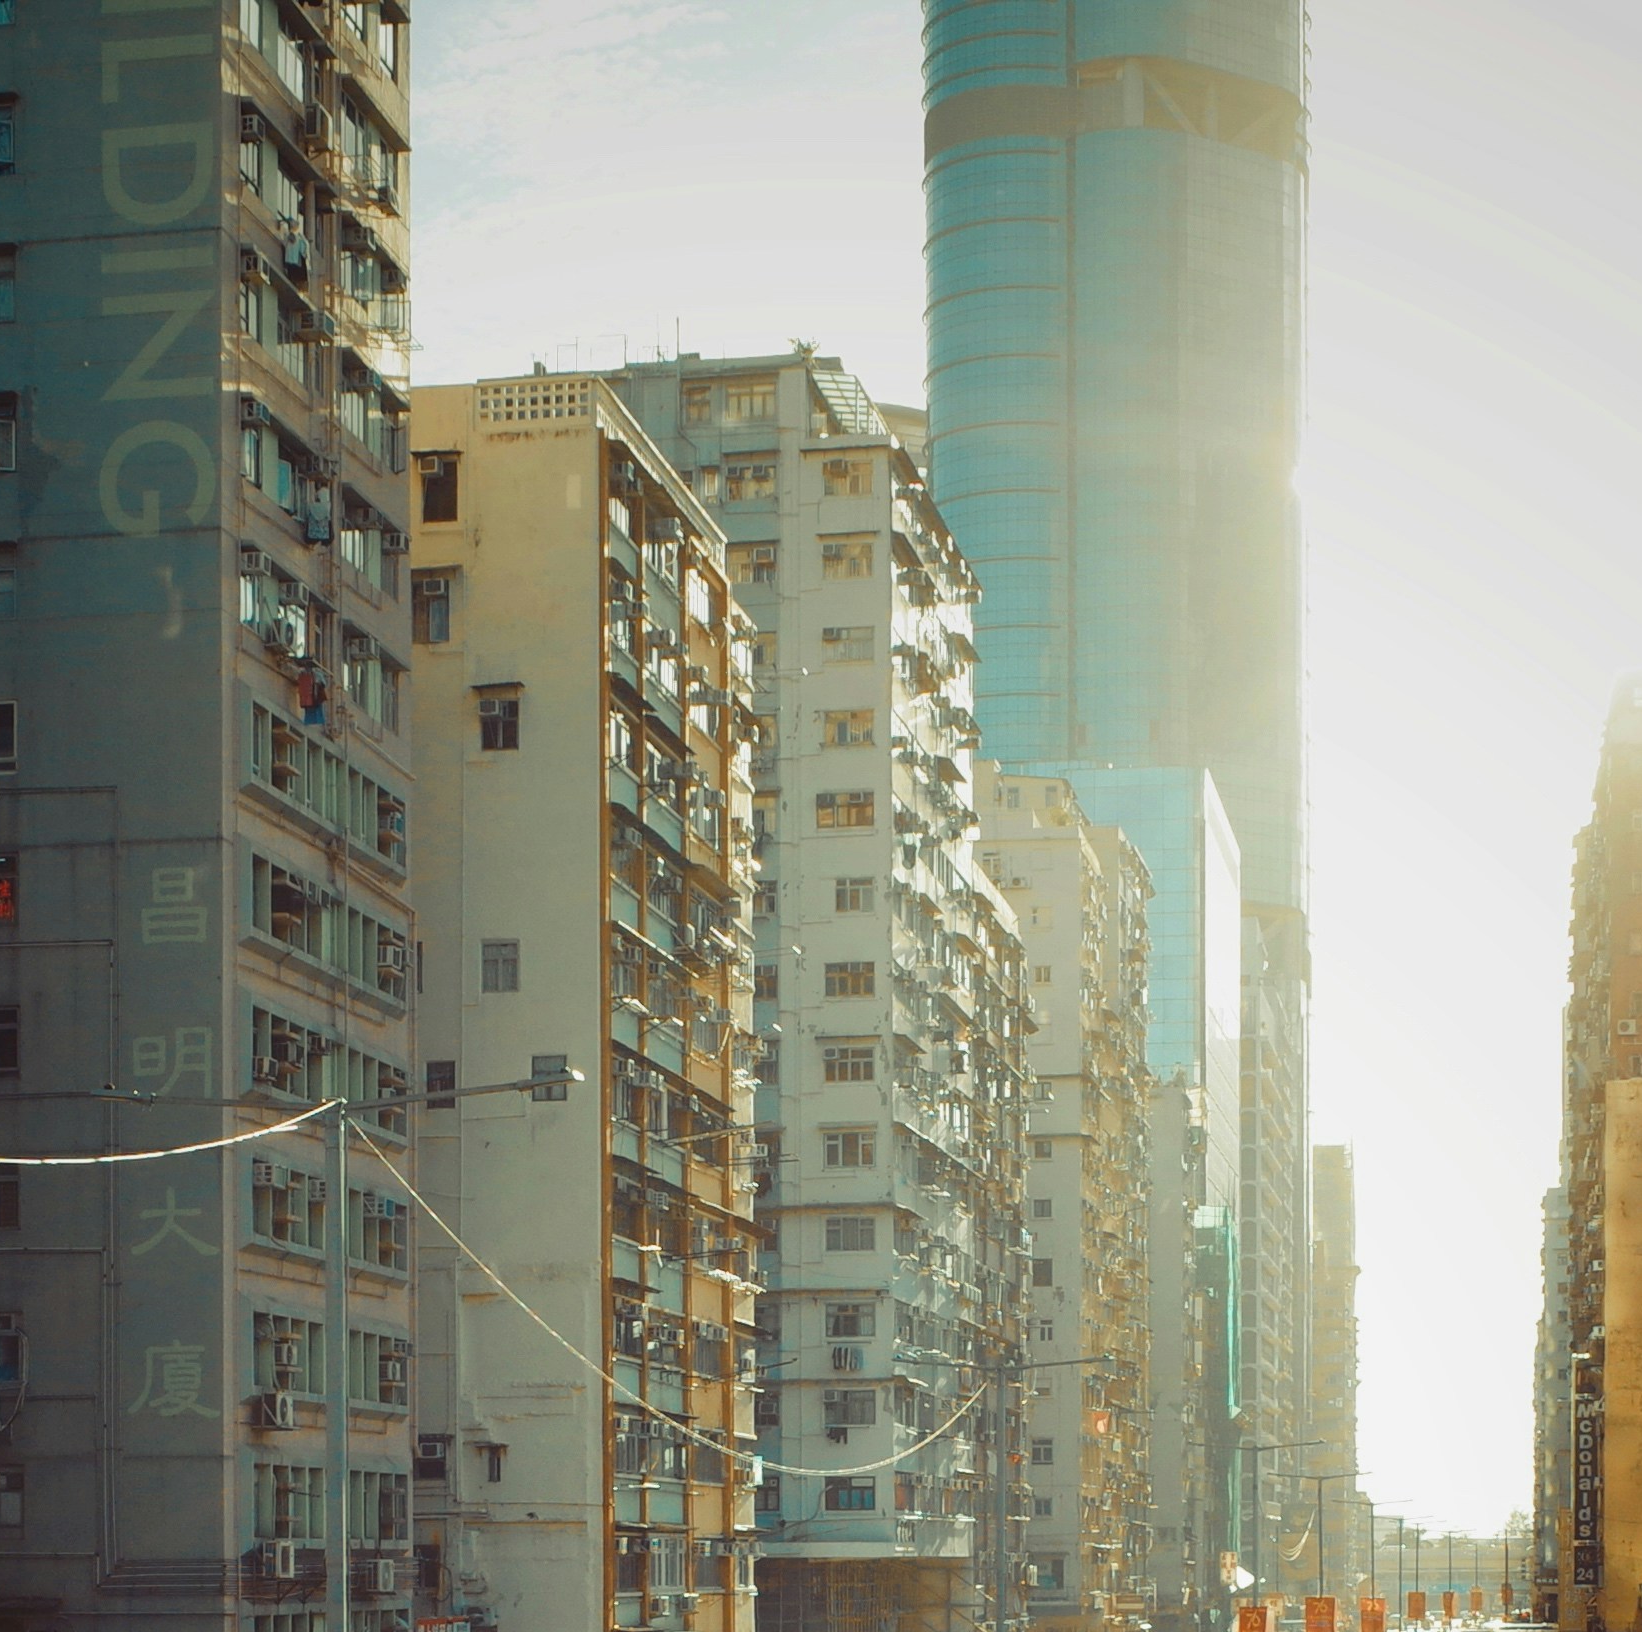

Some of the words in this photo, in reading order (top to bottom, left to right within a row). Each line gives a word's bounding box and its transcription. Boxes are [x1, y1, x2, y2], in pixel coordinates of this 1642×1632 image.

[127, 866, 220, 1419] 昌明大廈
[1576, 1402, 1597, 1538] McDonald's
[1576, 1567, 1594, 1581] 24
